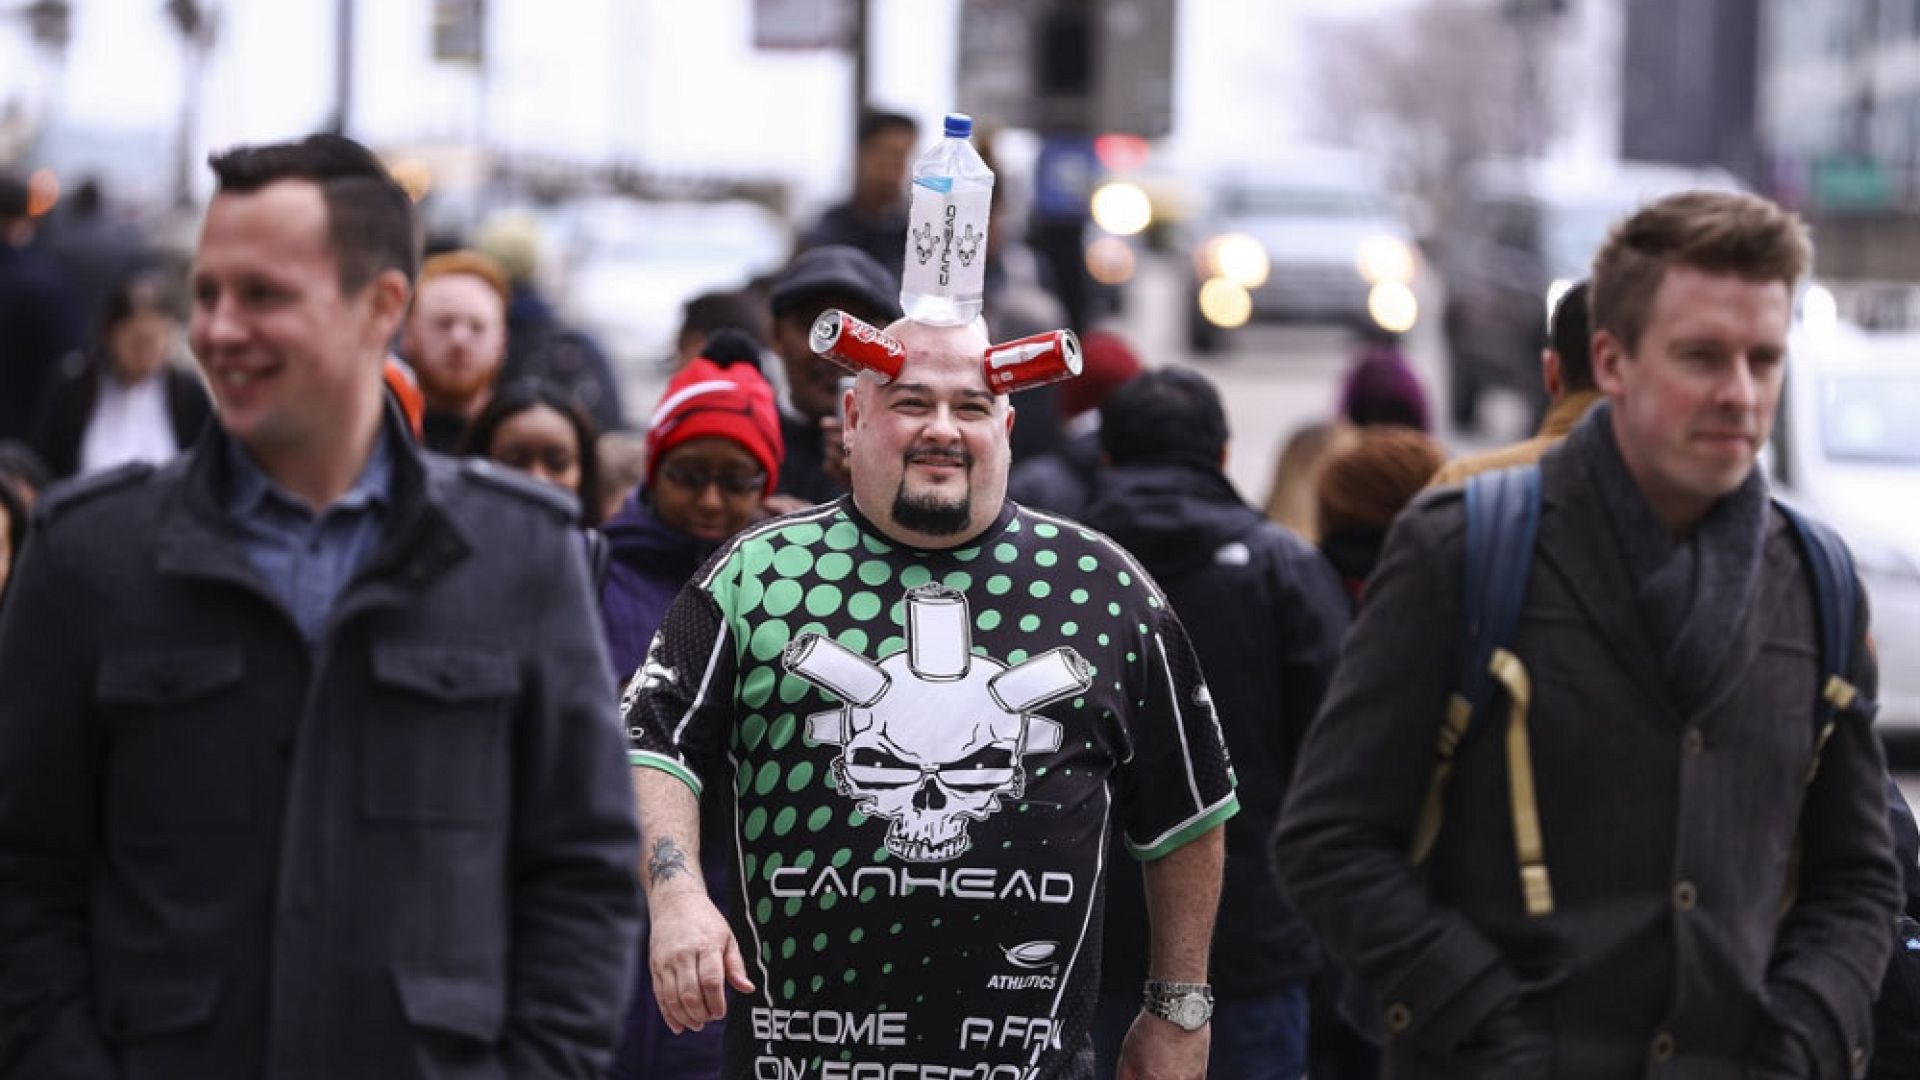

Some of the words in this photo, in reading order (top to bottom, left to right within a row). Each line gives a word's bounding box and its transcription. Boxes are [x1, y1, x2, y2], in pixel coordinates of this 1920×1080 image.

[939, 205, 956, 286] CANHEAD
[770, 867, 1074, 904] CANHEAD
[751, 1006, 907, 1046] BECOME
[959, 1017, 995, 1050] A
